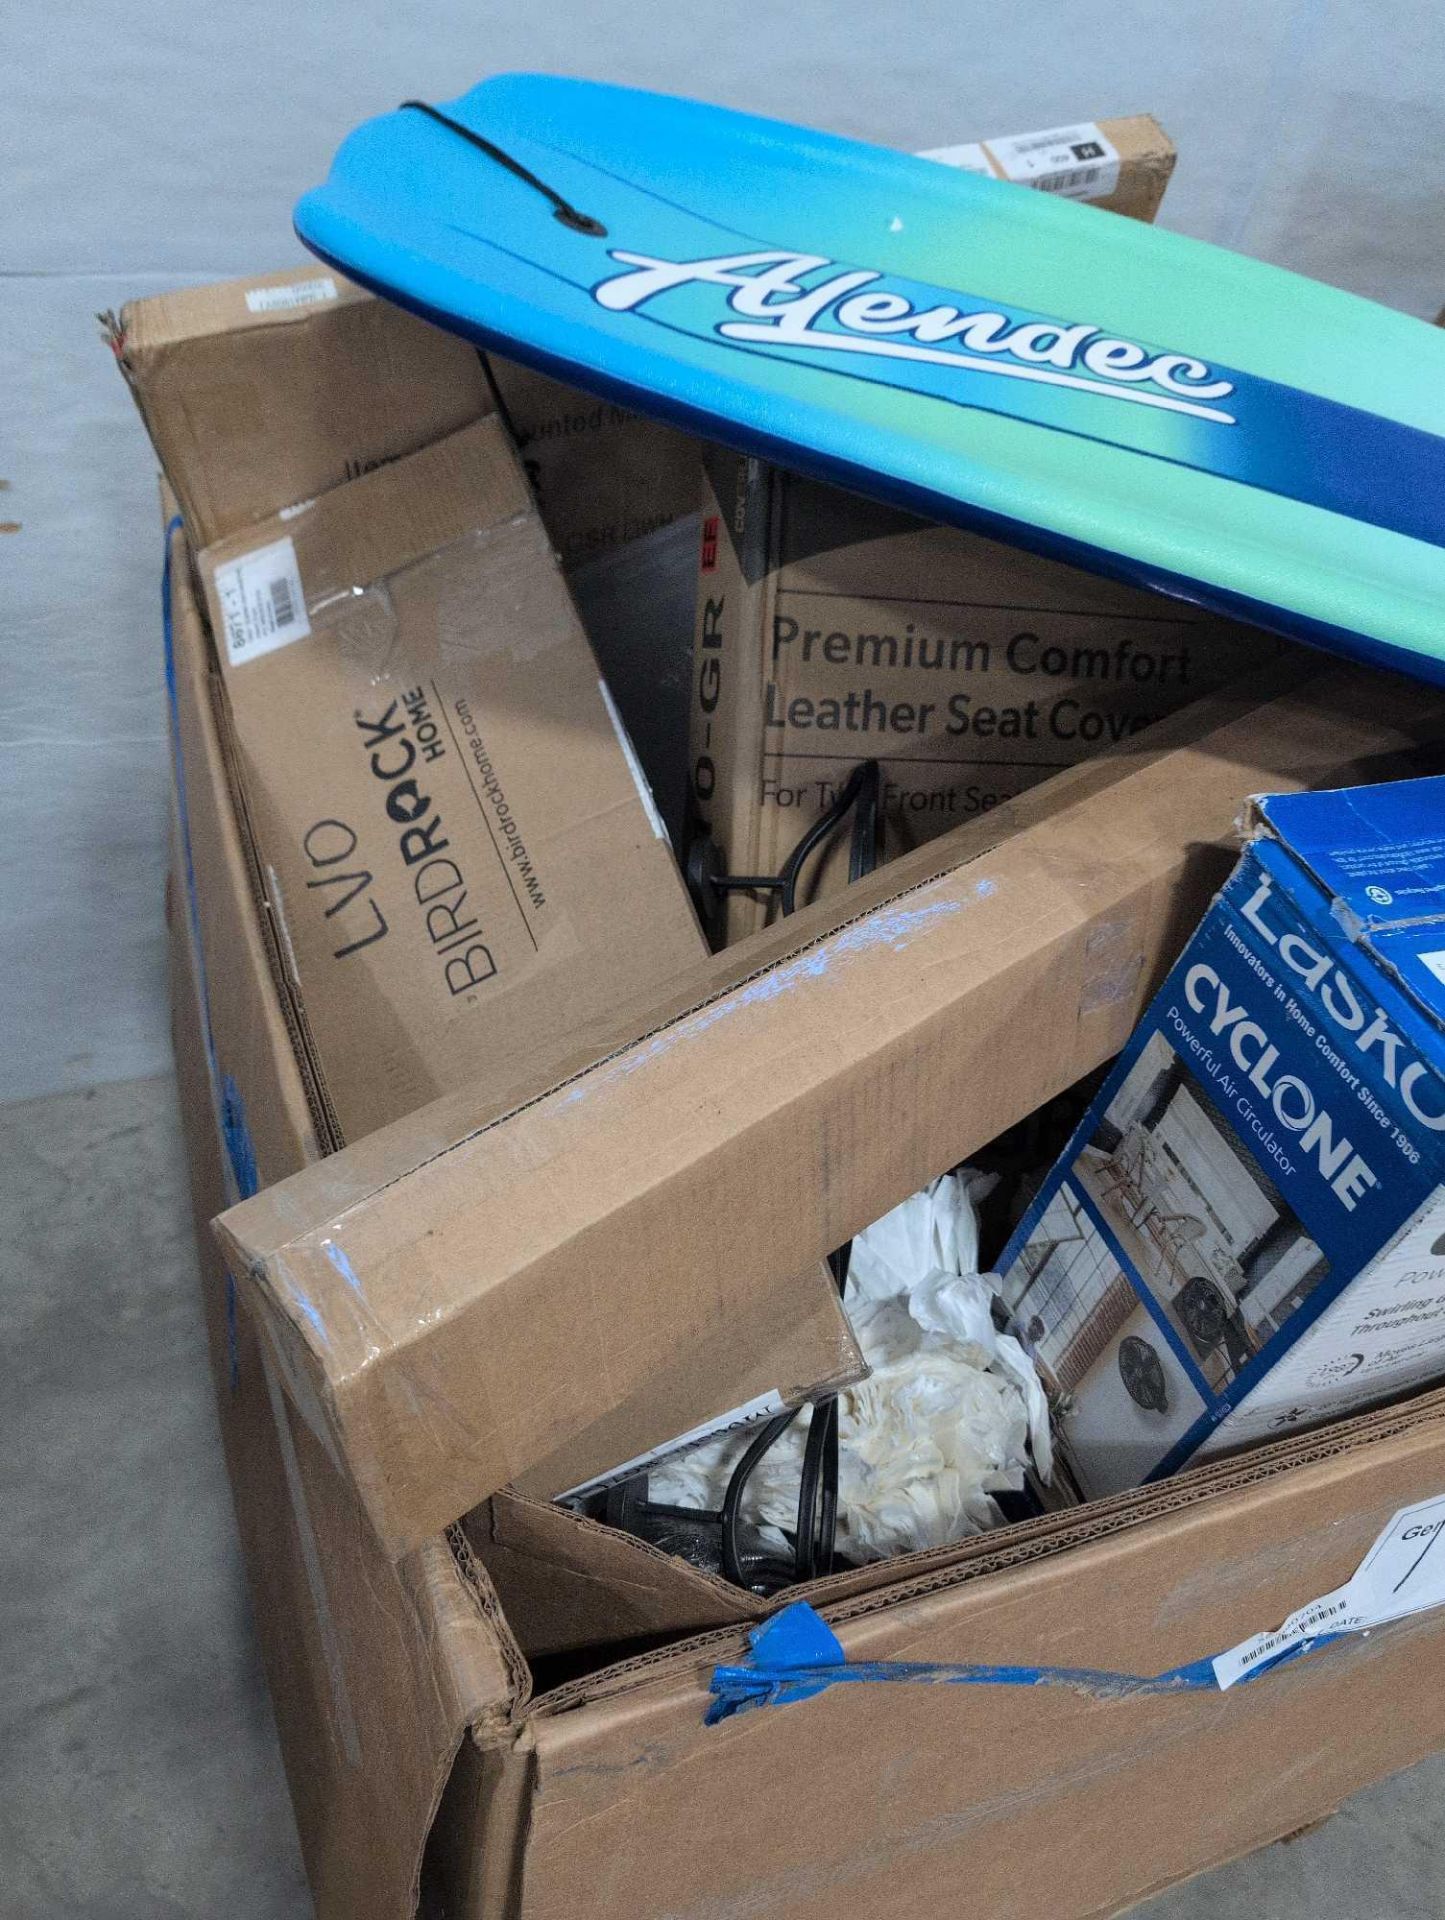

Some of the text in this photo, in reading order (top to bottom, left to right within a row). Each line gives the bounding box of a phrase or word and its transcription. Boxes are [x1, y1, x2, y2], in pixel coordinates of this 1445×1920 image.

[402, 686, 446, 763] HOME
[767, 683, 936, 733] Leather
[945, 694, 1039, 739] Seat
[773, 614, 1192, 686] Premium Comfort
[355, 700, 498, 995] BIRDROCK
[455, 699, 546, 910] www.birdrockhome.com
[761, 779, 807, 808] For
[884, 783, 954, 812] Front
[1166, 1005, 1296, 1177] Powerful Air Circulator
[1184, 963, 1378, 1212] CYCLONE
[1223, 923, 1421, 1165] Innovators in Home Comfort Since 1906
